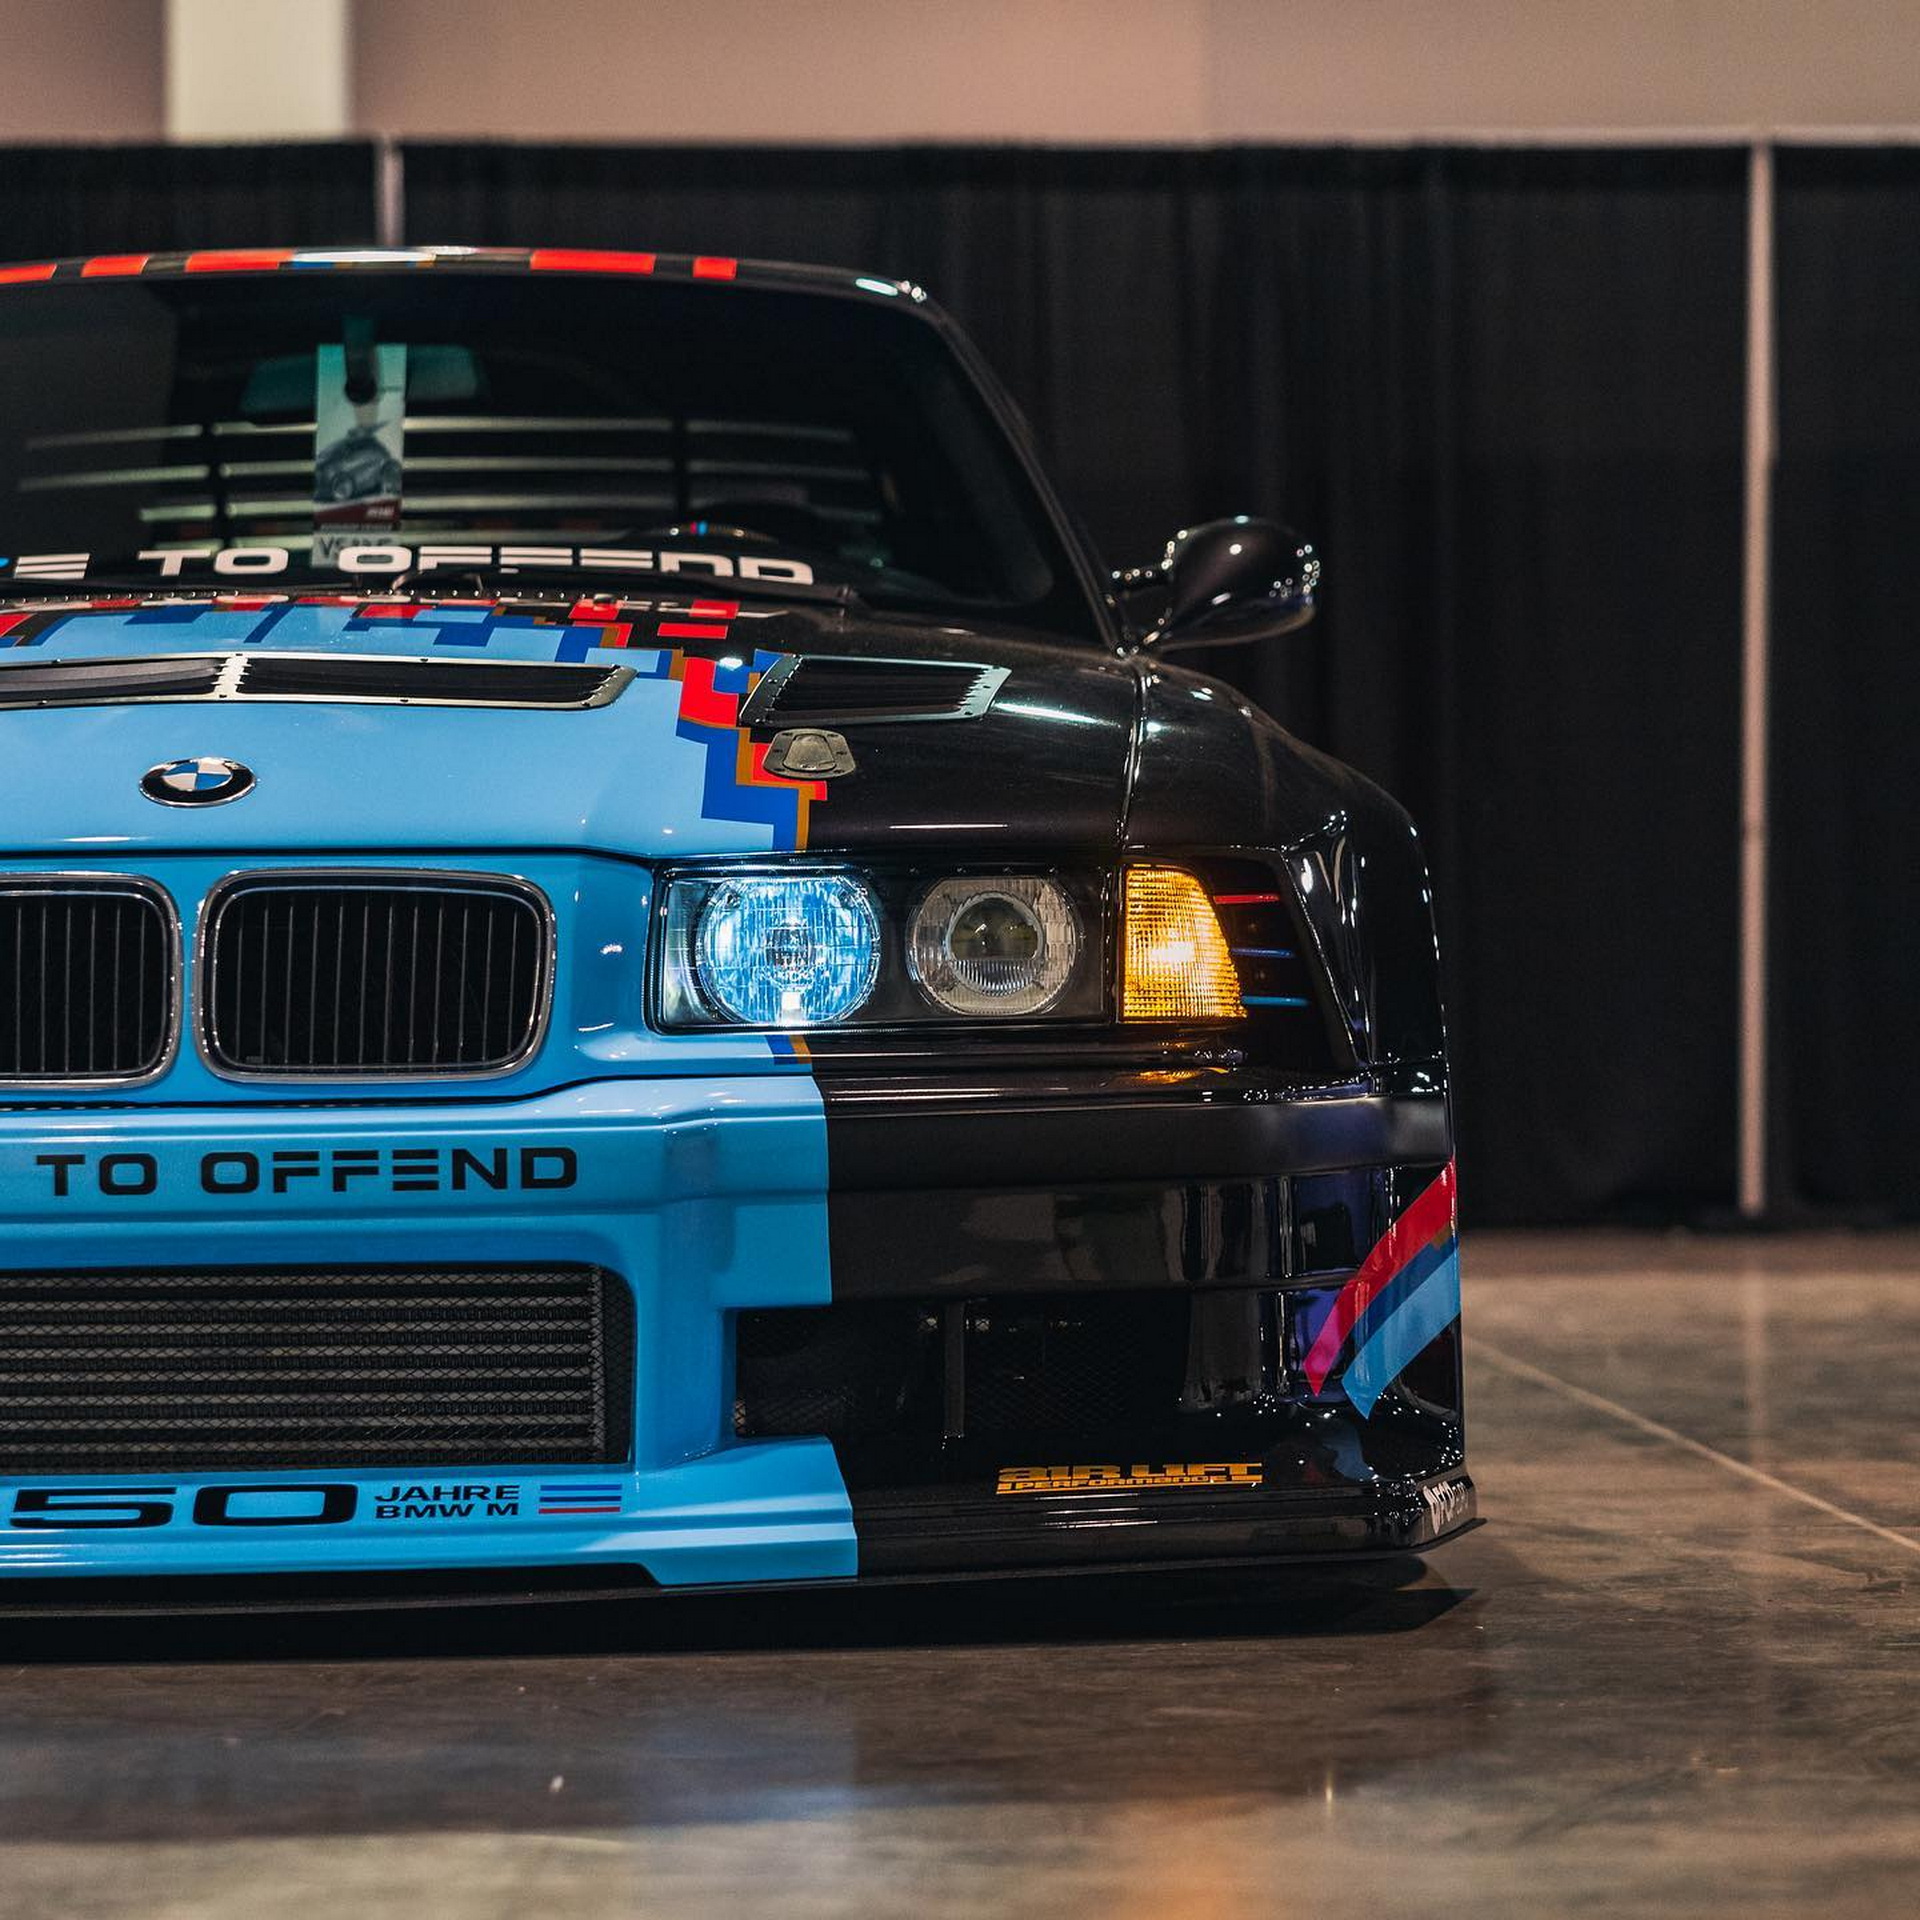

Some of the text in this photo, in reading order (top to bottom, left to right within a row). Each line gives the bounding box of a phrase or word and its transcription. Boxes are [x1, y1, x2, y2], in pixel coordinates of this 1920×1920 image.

[137, 548, 288, 576] TO
[338, 545, 814, 585] OFFEND
[36, 1147, 578, 1197] TO OFFEND
[9, 1484, 358, 1529] 50
[374, 1485, 520, 1502] JAHRE
[375, 1503, 519, 1519] BMW M
